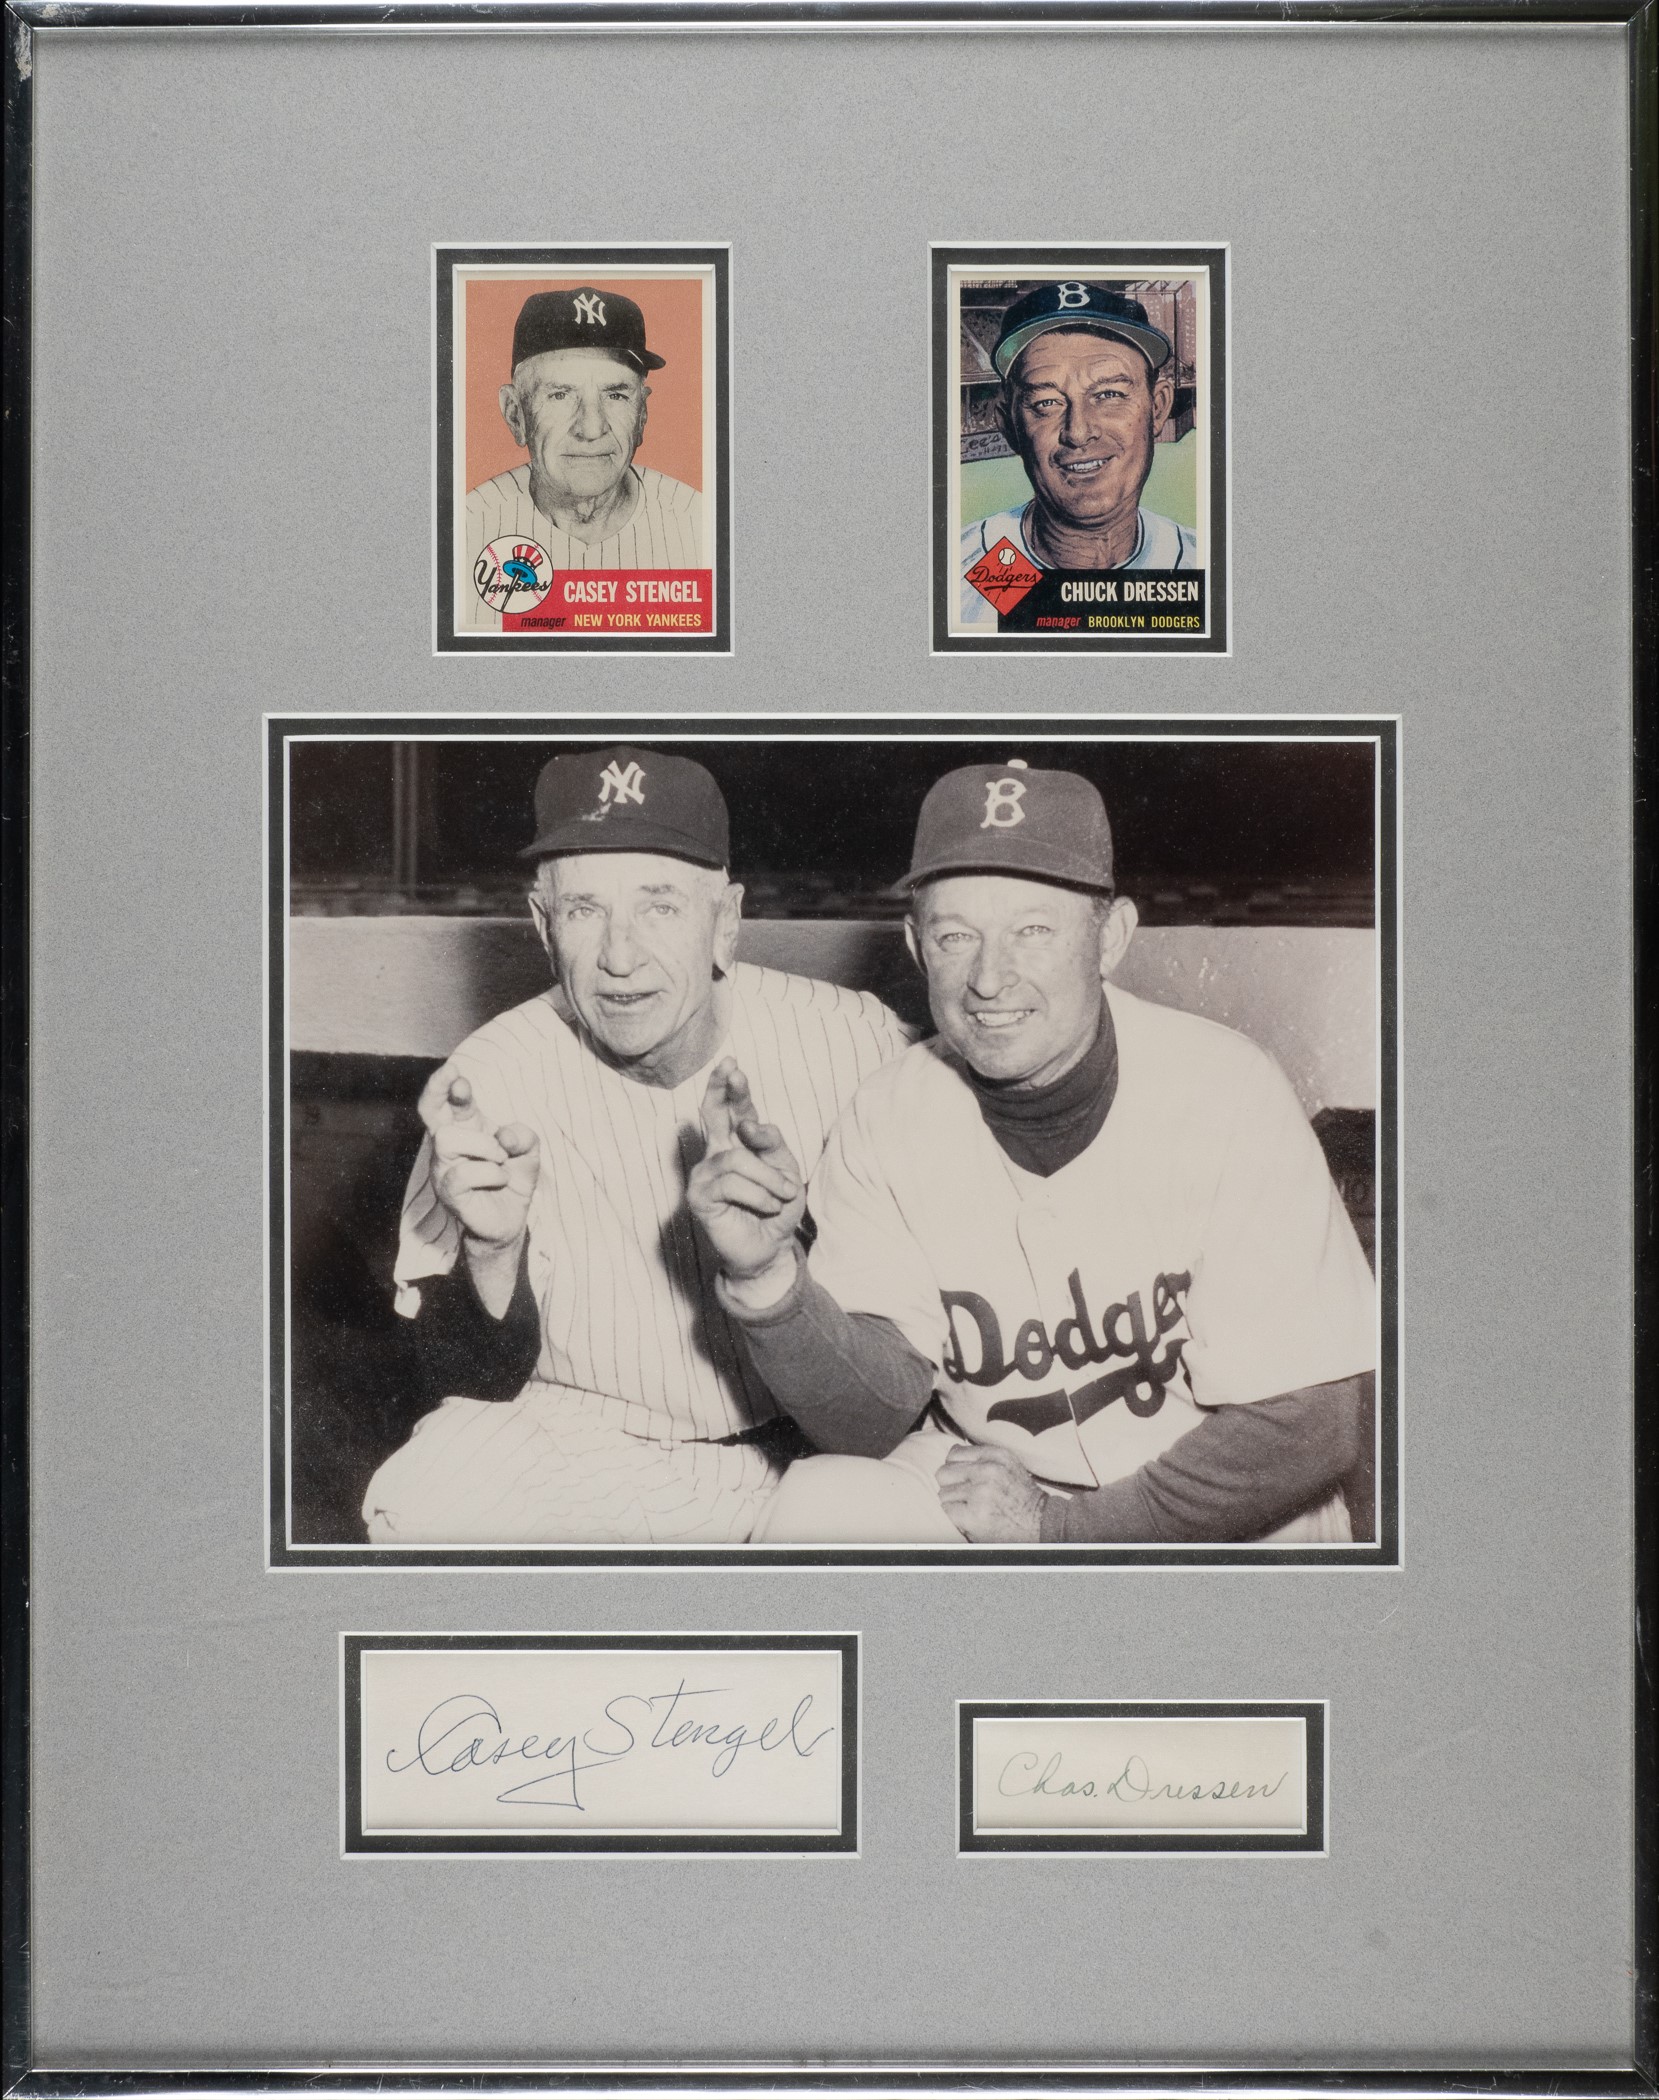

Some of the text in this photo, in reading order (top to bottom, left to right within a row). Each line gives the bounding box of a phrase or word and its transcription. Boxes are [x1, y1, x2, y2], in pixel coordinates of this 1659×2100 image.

[573, 293, 607, 326] NY
[1058, 281, 1090, 310] B
[474, 559, 551, 600] Yankees
[564, 580, 702, 603] CASEY STENGEL
[971, 565, 1038, 590] Dodgers
[1061, 581, 1199, 602] CHUCK DRESSEN
[521, 614, 702, 630] manager NEW YORK YANKEES
[1036, 616, 1200, 629] manager BROOKLYN DODGERS
[598, 760, 645, 805] NY
[980, 777, 1027, 828] B
[387, 1678, 835, 1810] Casey Stengel
[1107, 1755, 1289, 1803] Dressen
